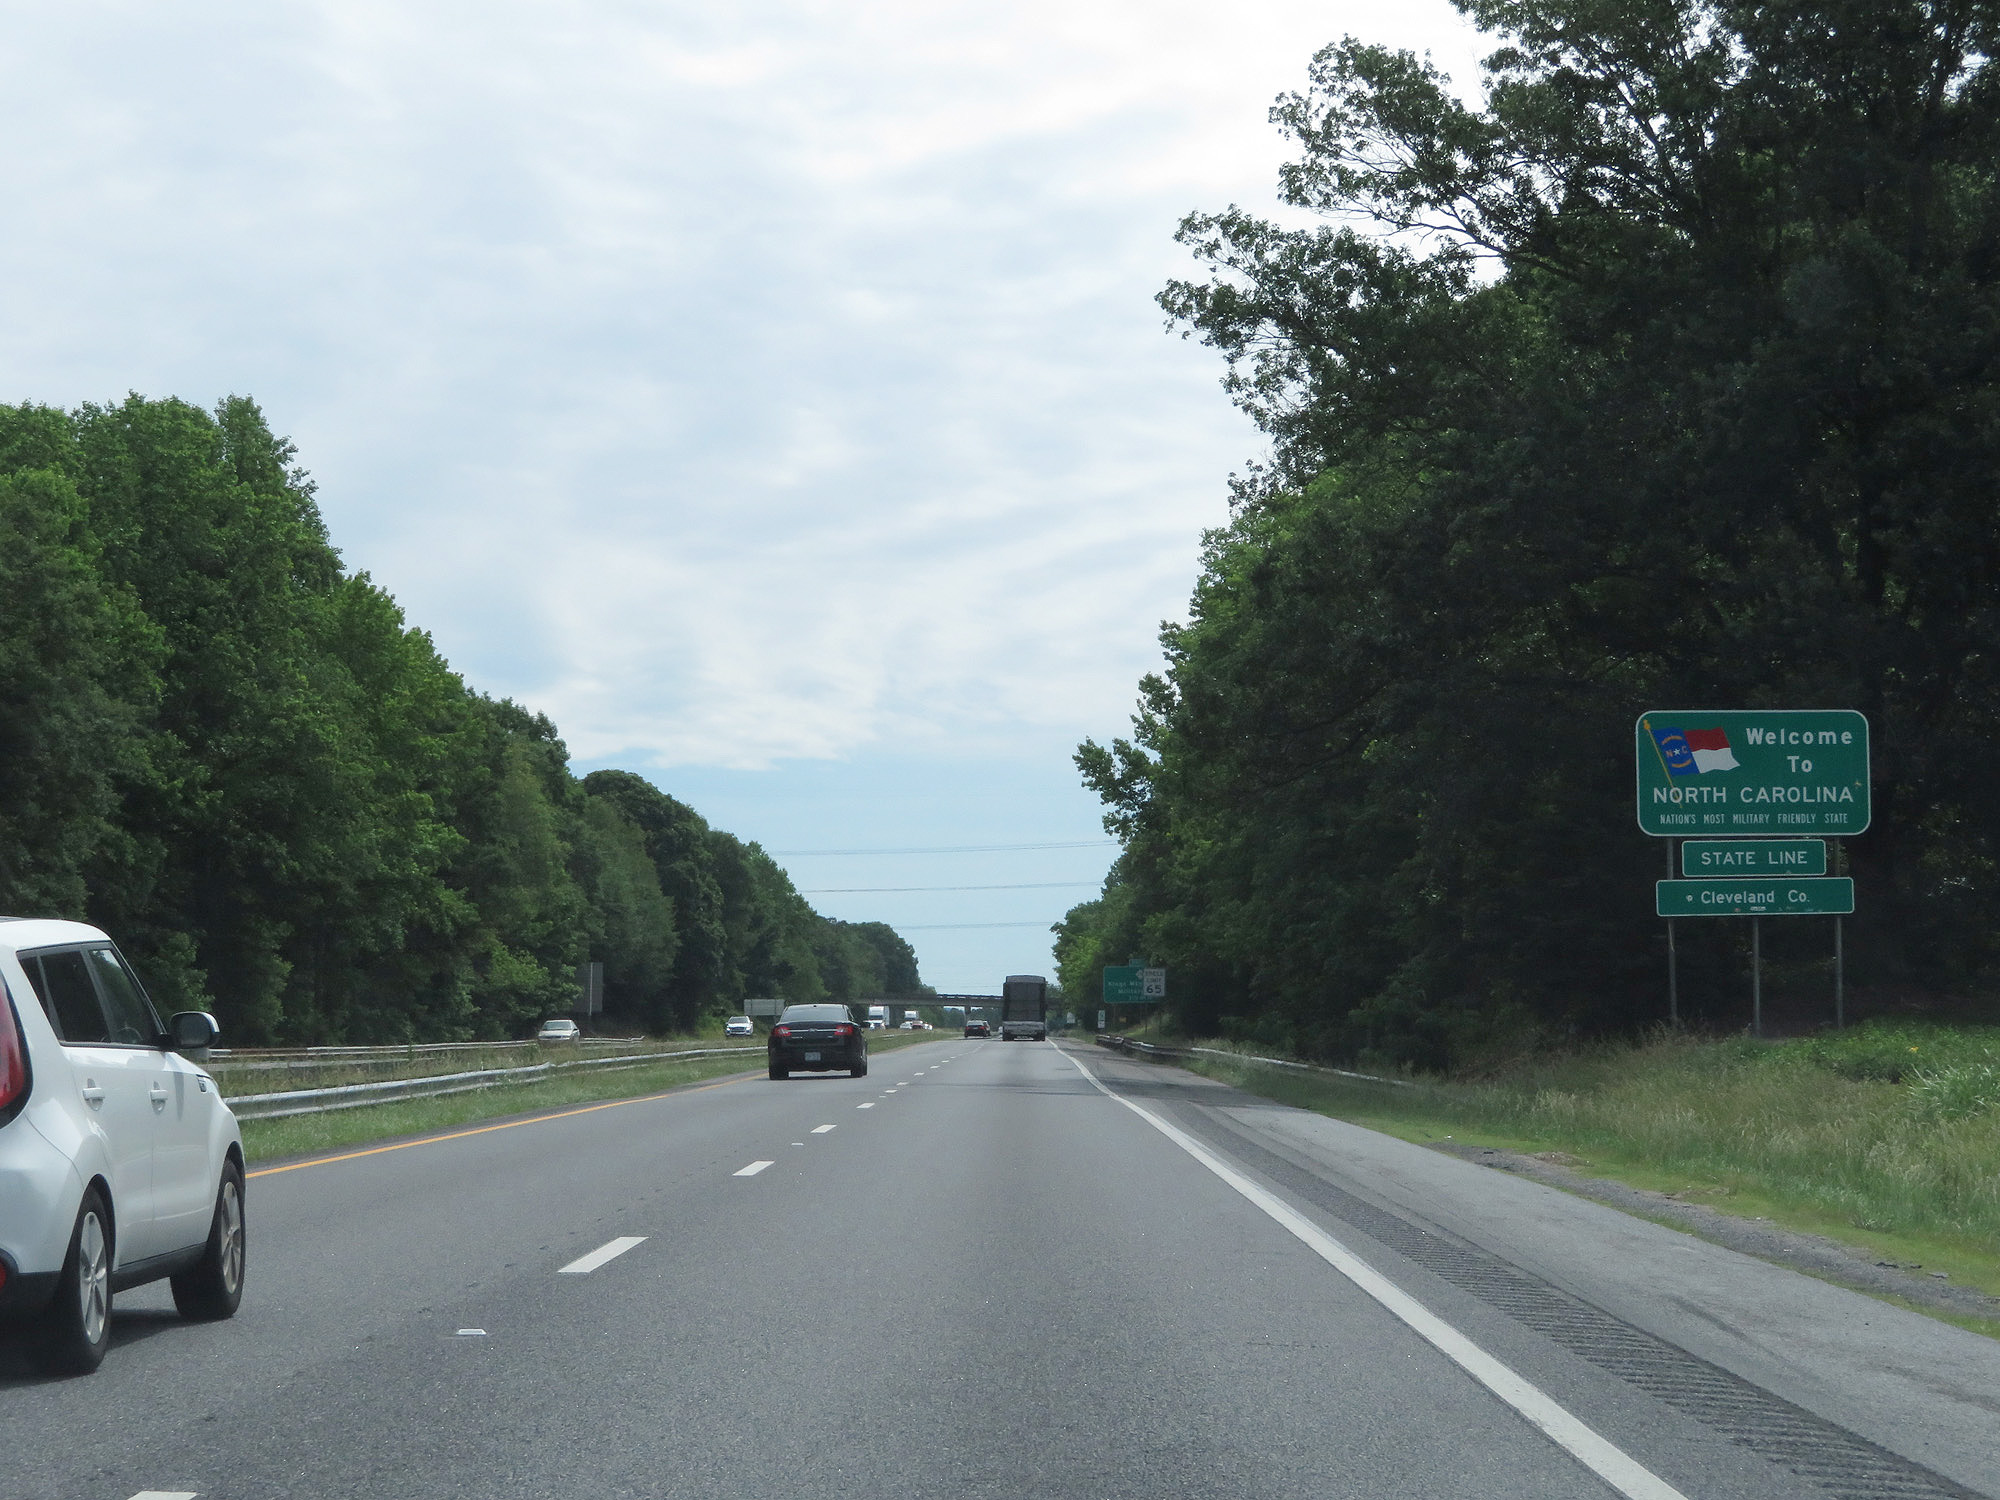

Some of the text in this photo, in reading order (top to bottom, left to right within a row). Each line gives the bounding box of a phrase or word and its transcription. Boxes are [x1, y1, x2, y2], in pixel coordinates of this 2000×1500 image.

[1746, 727, 1853, 745] Welcome
[1787, 755, 1813, 773] To
[1653, 786, 1854, 804] NORTH CAROLINA
[1660, 813, 1848, 825] NATION'S MOST MILITARY FRIENDLY STATE
[1701, 851, 1808, 865] STATE LINE
[1701, 889, 1811, 904] Cleveland Co.
[1146, 984, 1162, 994] 65
